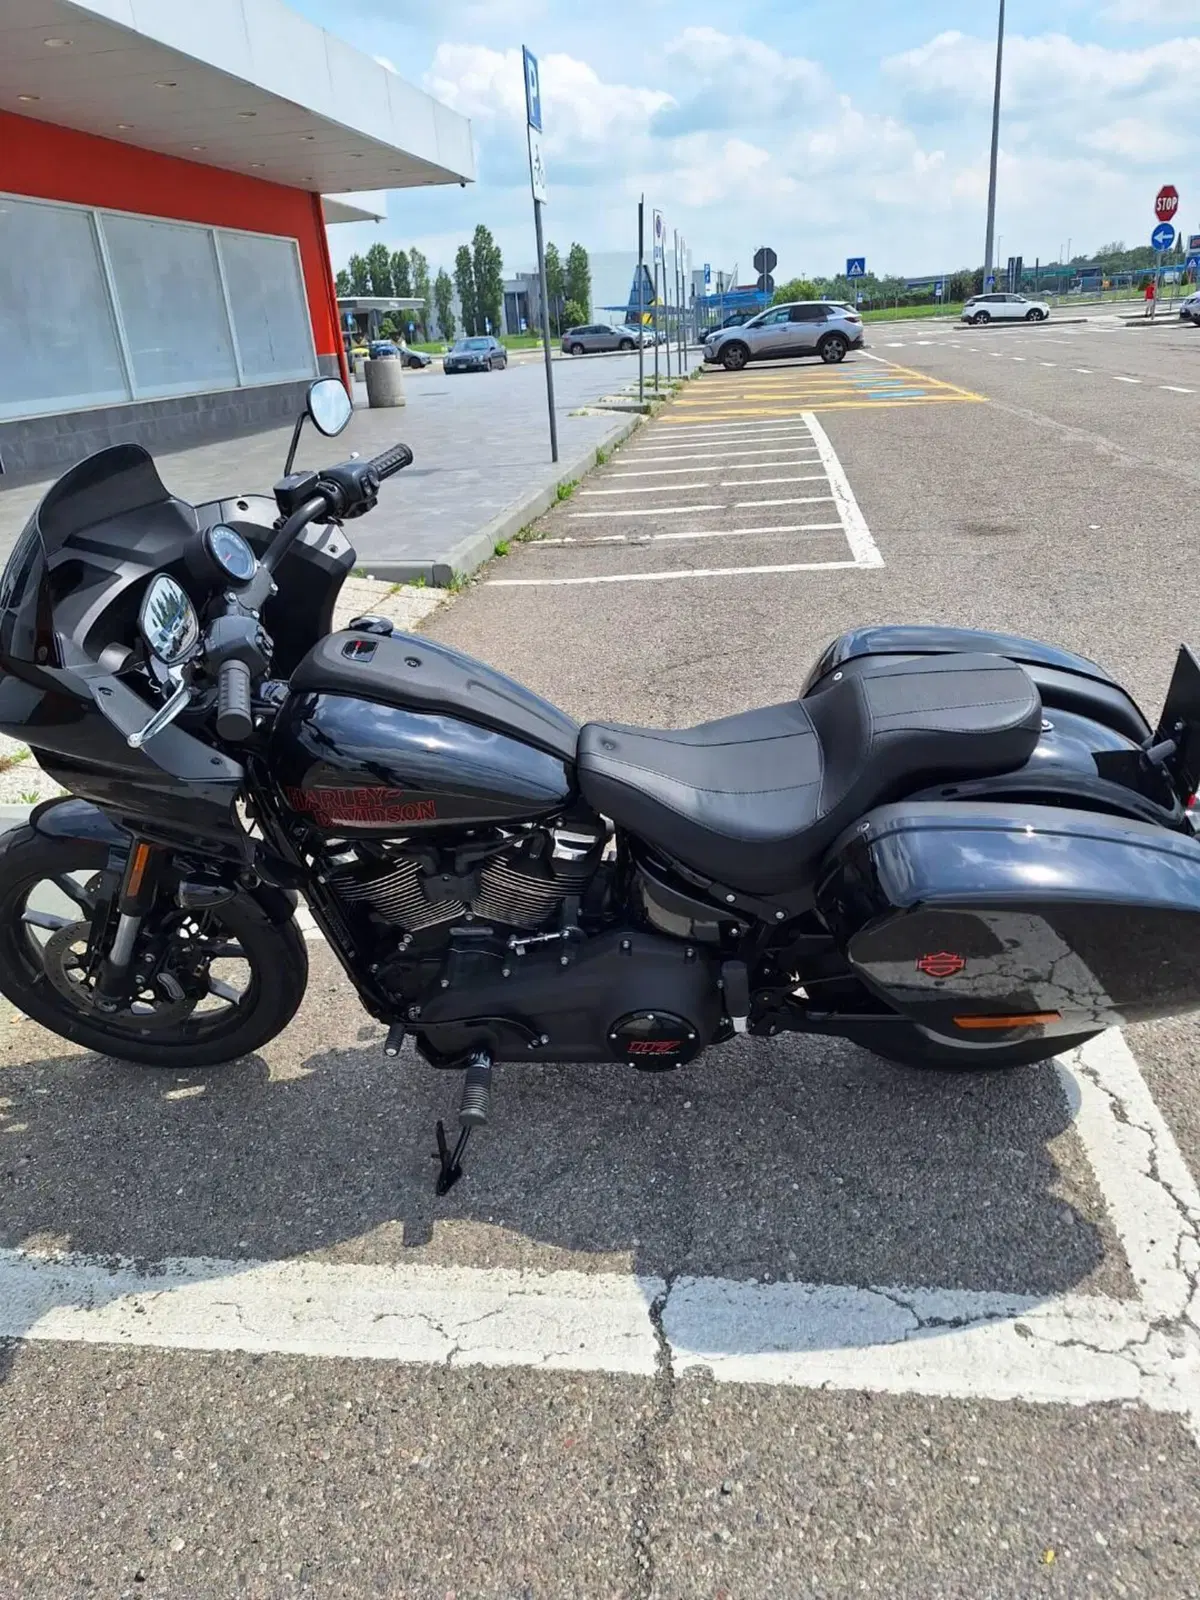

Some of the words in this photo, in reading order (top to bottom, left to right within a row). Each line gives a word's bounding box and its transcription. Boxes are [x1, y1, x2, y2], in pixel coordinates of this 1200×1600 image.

[527, 58, 538, 117] P
[1156, 197, 1178, 212] STOP
[314, 800, 437, 827] DAVIDSON
